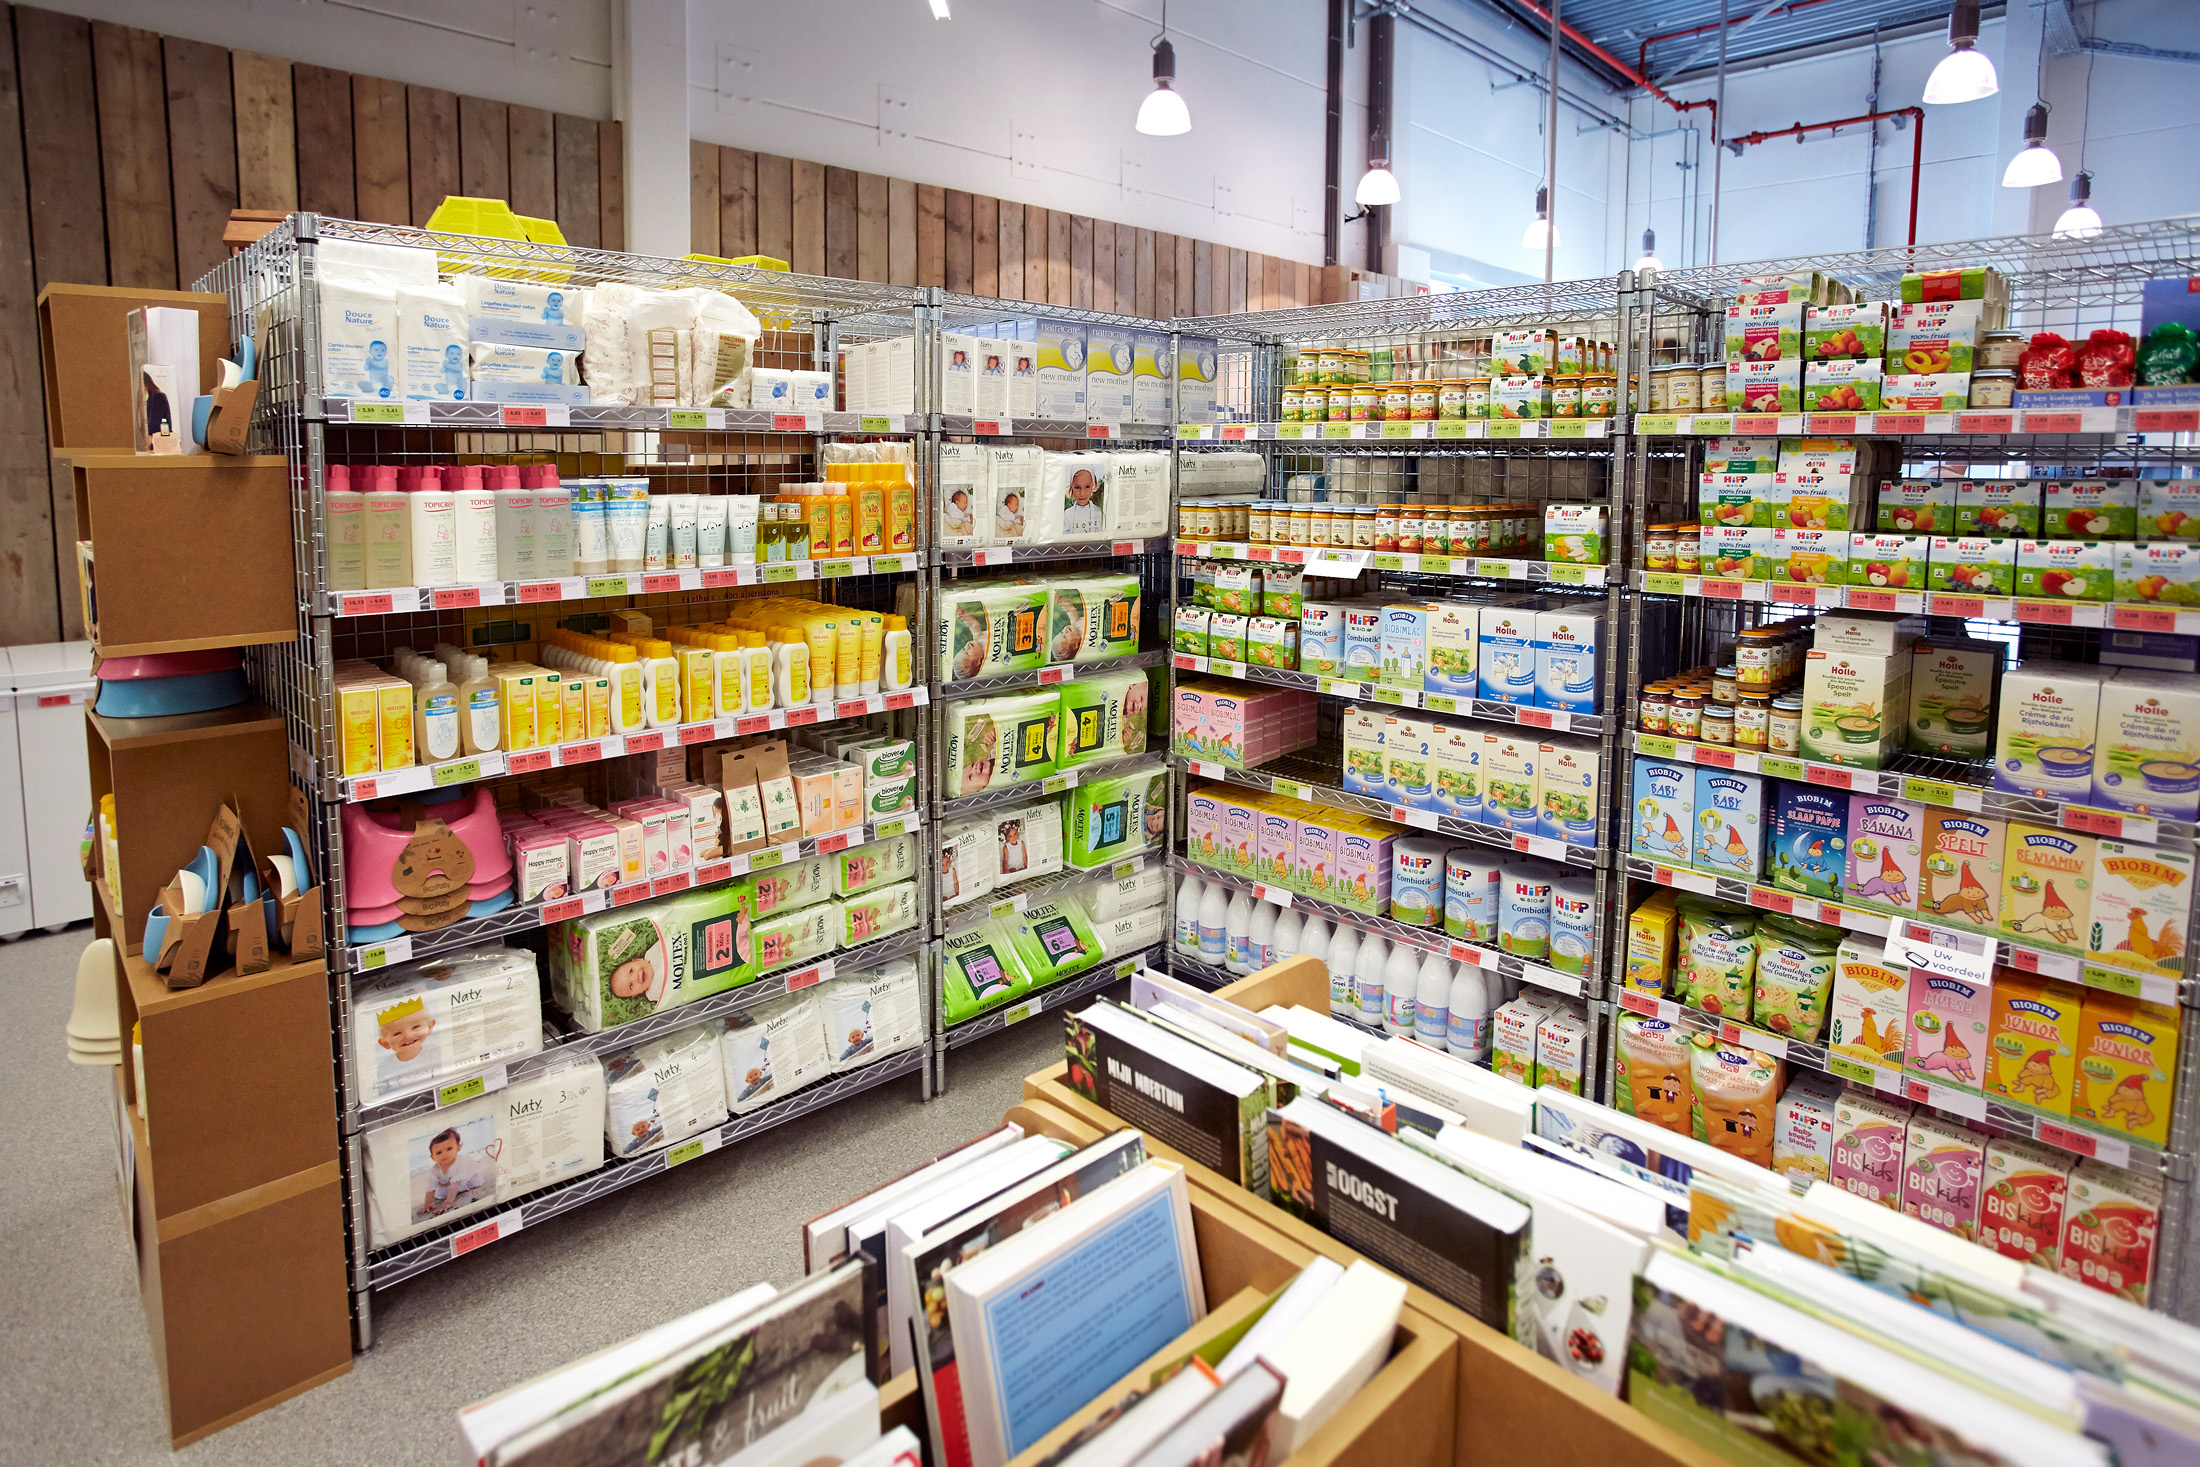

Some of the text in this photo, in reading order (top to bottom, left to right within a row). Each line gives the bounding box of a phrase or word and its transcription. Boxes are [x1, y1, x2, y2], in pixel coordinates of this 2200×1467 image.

[346, 310, 372, 318] Douce
[424, 315, 449, 323] Douce
[1041, 323, 1080, 334] natracare
[1762, 318, 1779, 327] fruit
[1917, 318, 1946, 327] HiPP
[1092, 328, 1128, 338] natracare
[1138, 334, 1170, 342] natracare
[1509, 334, 1527, 342] HiPP
[1041, 372, 1081, 382] new mother
[1092, 376, 1128, 386] new mother
[1724, 475, 1747, 483] HiPP
[1798, 475, 1823, 484] HiPP
[1985, 485, 2015, 493] HiPP
[1724, 529, 1747, 537] HiPP
[1797, 532, 1822, 540] HiPP
[1735, 540, 1751, 549] fruit
[1809, 544, 1826, 552] fruit
[1876, 539, 1904, 547] HiPP
[1959, 542, 1990, 550] HiPP
[1303, 609, 1328, 620] HiPP
[1349, 613, 1379, 626] HiPP
[1390, 613, 1416, 622] BIOBIM
[1089, 606, 1098, 647] MOLTEX
[1385, 624, 1420, 635] BIOBIMLAC
[1496, 626, 1517, 635] Holle
[992, 619, 1001, 662] MOLTEX
[1465, 629, 1470, 640] 1
[1552, 631, 1575, 641] Holle
[1582, 643, 1590, 653] 2
[1832, 666, 1856, 676] Holle
[1939, 661, 1964, 671] Holle
[1828, 682, 1858, 692] Épeautre
[2033, 693, 2063, 704] Holle
[2020, 710, 2046, 719] Crème
[2050, 713, 2061, 721] de
[2135, 704, 2169, 716] Holle
[1082, 716, 1091, 726] 4
[1110, 699, 1118, 740] MOLTEX
[2021, 717, 2070, 729] Rijstvlokken
[1377, 732, 1385, 744] 2
[2123, 730, 2177, 742] Rijstvlokken
[882, 748, 900, 760] biover
[1001, 730, 1011, 774] MOLTEX
[1032, 743, 1042, 754] 4
[1421, 743, 1428, 755] 2
[1502, 749, 1518, 758] Holle
[1471, 752, 1479, 765] 2
[1558, 759, 1576, 768] Holle
[1525, 763, 1533, 776] 3
[1583, 773, 1592, 787] 3
[880, 786, 900, 796] biover
[1650, 783, 1677, 796] BABY
[1713, 794, 1741, 808] BABY
[1797, 795, 1833, 807] BIOBIM
[1106, 813, 1115, 822] 5
[1787, 810, 1813, 822] SLAAP
[1861, 818, 1913, 838] BANANA
[1943, 820, 1986, 835] BIOBIM
[1261, 827, 1292, 841] BIOBIMLAC
[1300, 837, 1332, 851] BIOBIMLAC
[1937, 833, 1989, 855] SPELT
[2027, 836, 2073, 852] BIOBIM
[582, 844, 614, 857] Happy mama
[1340, 848, 1374, 862] BIOBIMLAC
[528, 856, 562, 869] Happy mama
[1401, 855, 1432, 868] HiPP
[2017, 849, 2084, 872] BENJAMIN
[2108, 860, 2177, 882] BIOBIM
[1119, 877, 1136, 892] Naty
[1023, 904, 1057, 920] MOLTEX
[1115, 920, 1133, 934] Naty
[945, 931, 981, 950] MOLTEX
[1710, 940, 1726, 949] Baby
[716, 947, 729, 960] 2
[1934, 950, 1952, 961] Uw
[672, 935, 684, 990] MOLTEX
[1781, 958, 1800, 968] Baby
[1767, 961, 1812, 978] Rijstwafeltjes
[1932, 962, 1985, 980] voordeel
[1846, 966, 1898, 986] BIOBIM
[451, 977, 512, 1007] Naty 2
[1930, 980, 1972, 997] BIOBIM
[2011, 1002, 2058, 1019] BIOBIM
[766, 1016, 788, 1033] Naty
[2002, 1015, 2060, 1041] JUNIOR
[2102, 1024, 2151, 1042] BIOBIM
[1654, 1050, 1684, 1060] CAROTTE
[2092, 1038, 2153, 1066] JUNIOR
[1135, 1071, 1184, 1113] MOESTUIN
[510, 1090, 566, 1117] Naty 3
[1789, 1112, 1818, 1125] HiPP
[1793, 1127, 1813, 1137] Baby
[1788, 1132, 1817, 1145] koekjes
[1789, 1137, 1815, 1150] biscuit
[1837, 1147, 1894, 1182] BISkids
[1338, 1167, 1398, 1221] OOGST
[1909, 1172, 1972, 1209] BISkids
[1987, 1197, 2053, 1235] BISkids
[743, 1373, 799, 1447] fruit
